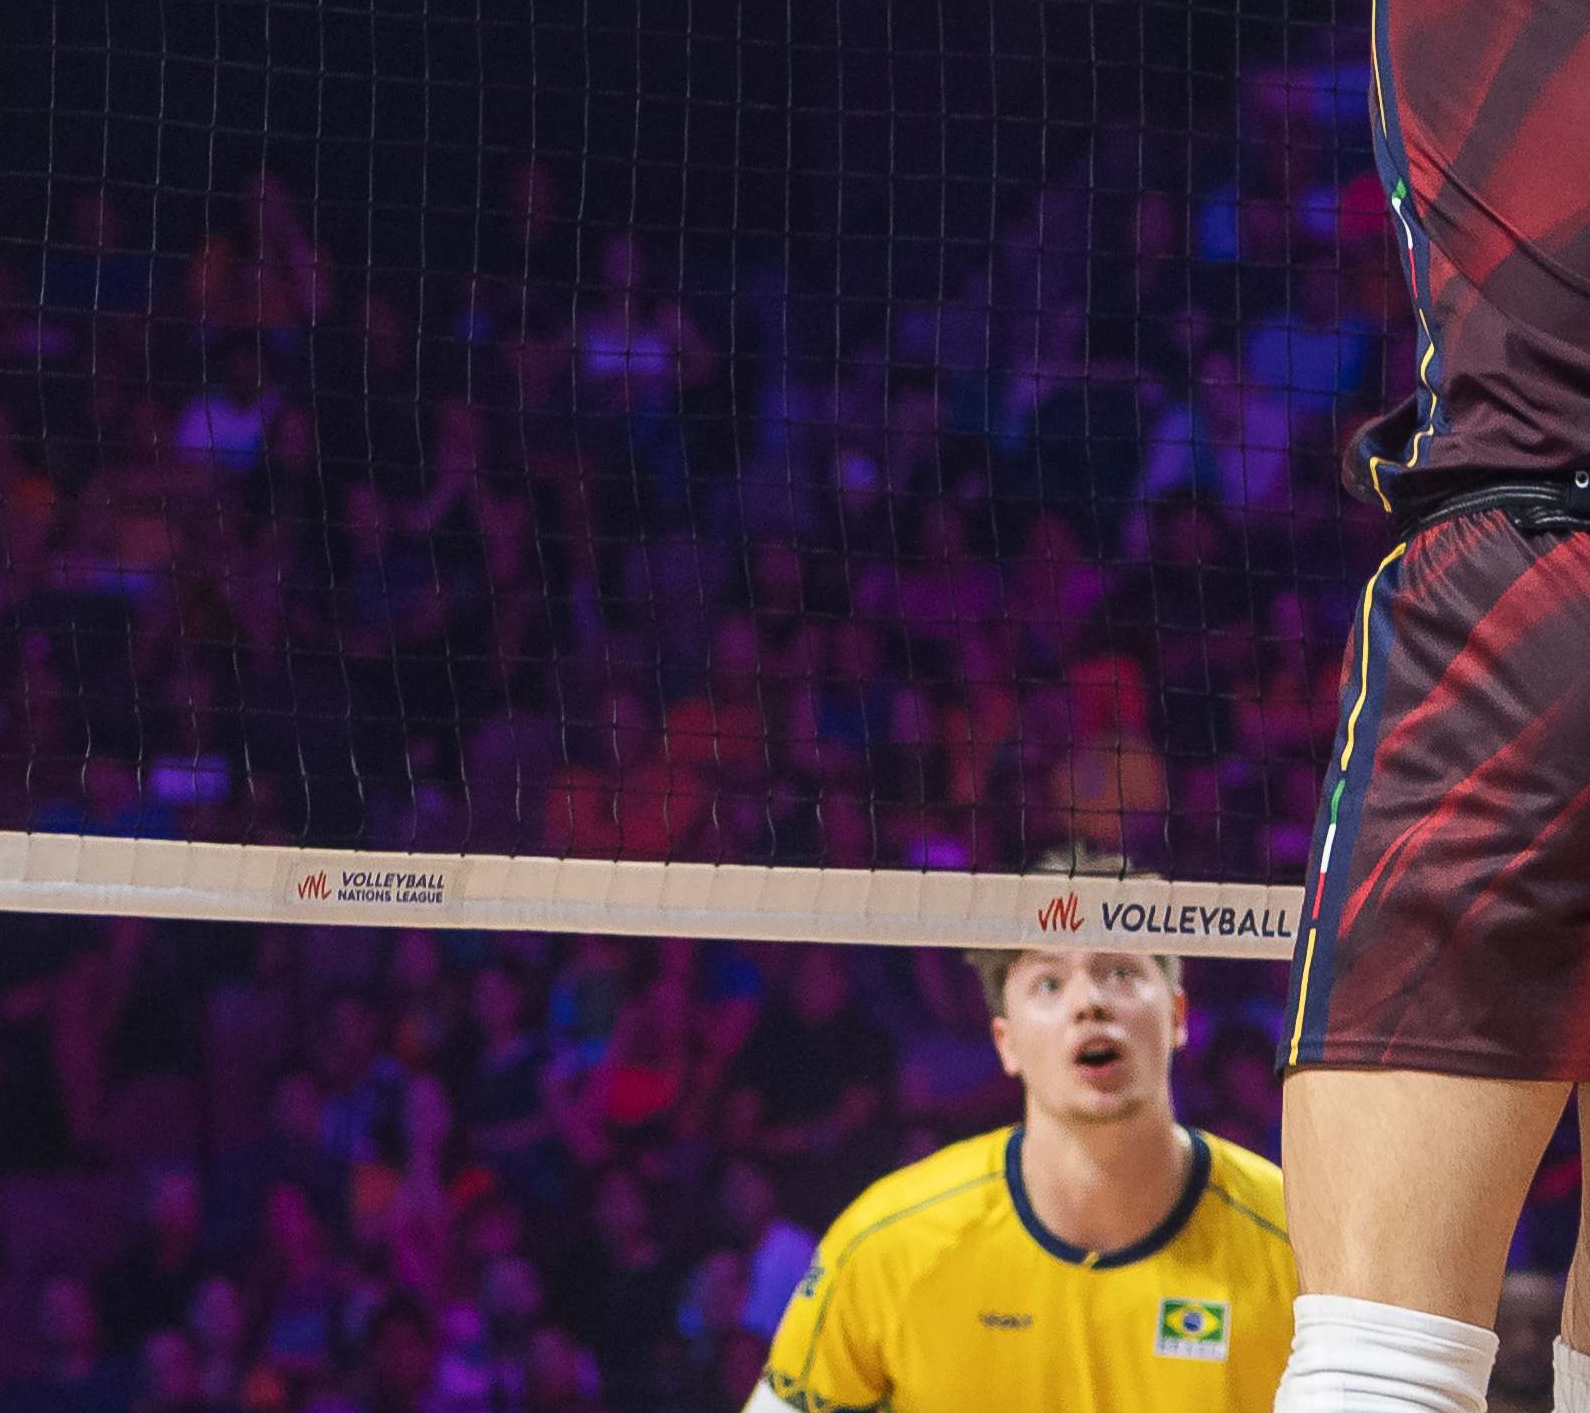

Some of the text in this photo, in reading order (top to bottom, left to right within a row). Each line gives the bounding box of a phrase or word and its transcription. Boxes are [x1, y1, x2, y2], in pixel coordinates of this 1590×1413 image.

[341, 871, 444, 889] VOLLEYBALL
[337, 889, 443, 904] NATIONS LEAGUE
[1102, 902, 1292, 938] VOLLEYBALL
